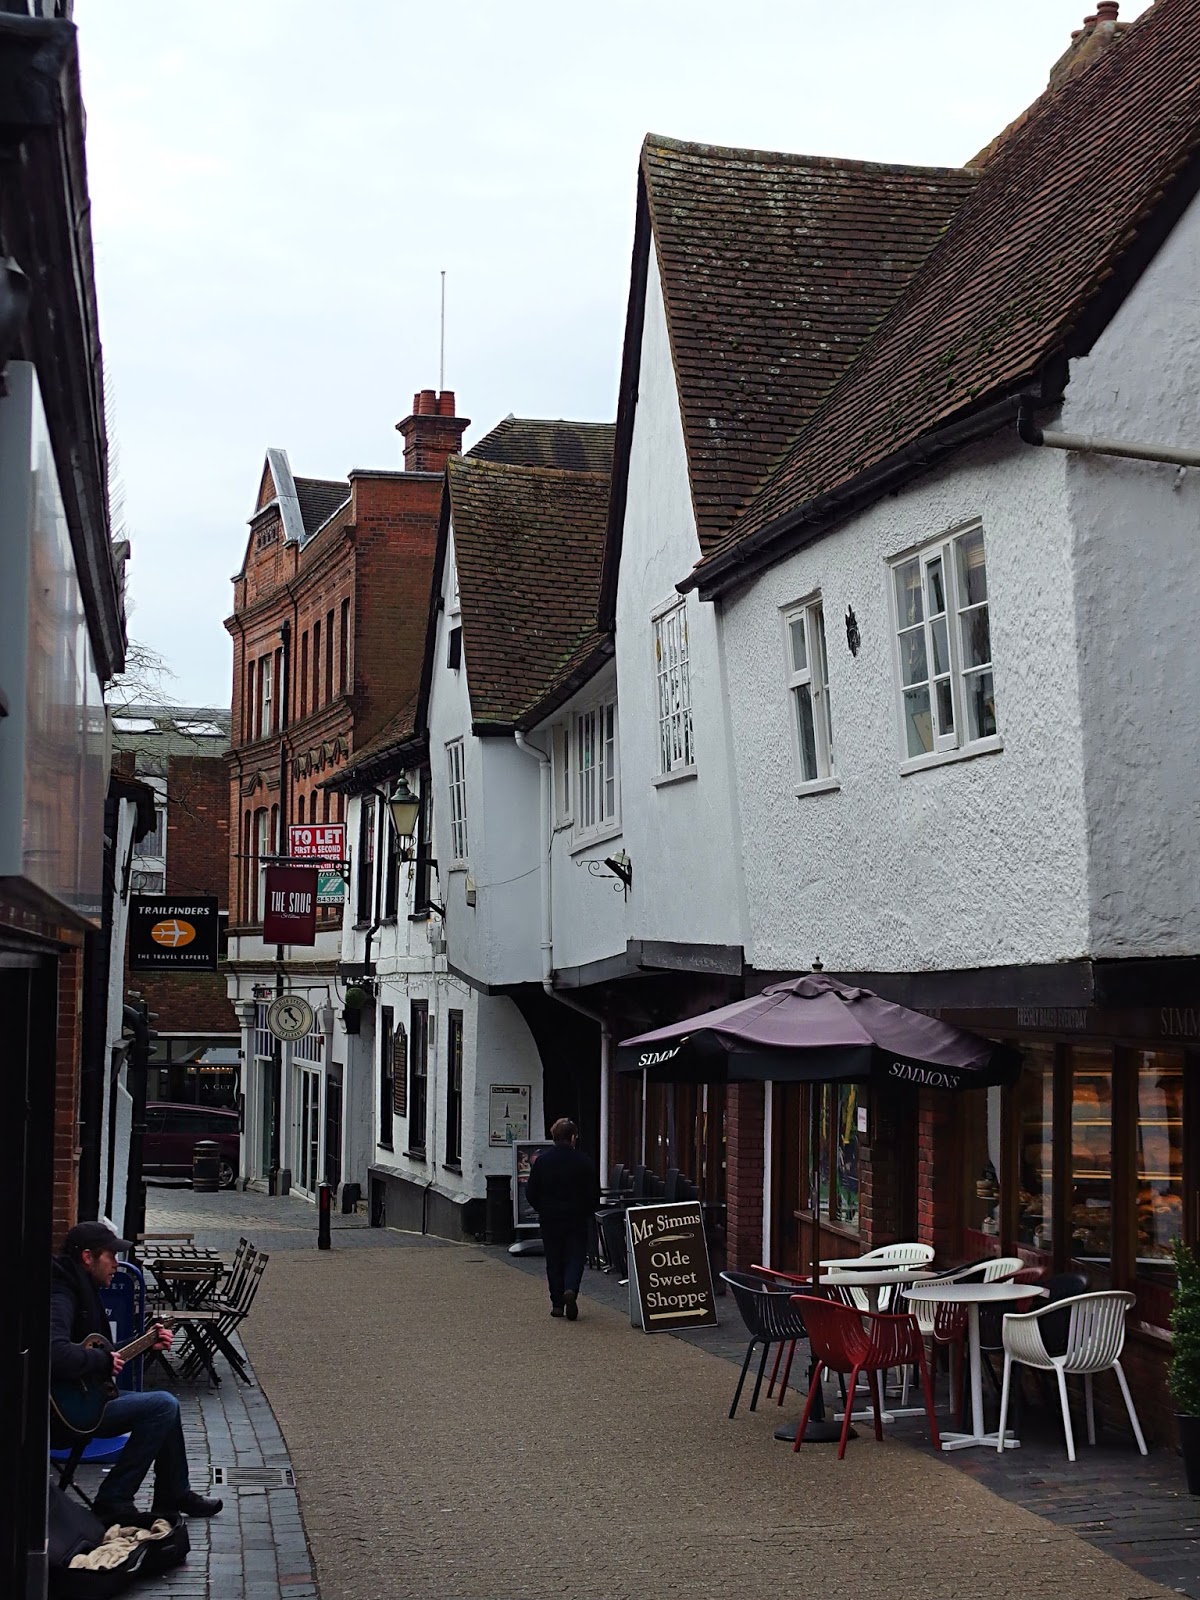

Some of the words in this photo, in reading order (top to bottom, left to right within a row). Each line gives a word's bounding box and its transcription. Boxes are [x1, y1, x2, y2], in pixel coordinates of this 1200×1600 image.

[292, 830, 312, 846] TO
[316, 829, 342, 845] LET
[294, 846, 311, 854] FIRST
[318, 845, 341, 853] SECOND
[138, 906, 211, 916] TRAILFINDERS
[271, 891, 286, 912] THE
[289, 892, 311, 914] SNUG
[138, 953, 151, 961] THE
[888, 1062, 961, 1089] SIMMONS
[632, 1219, 654, 1246] Mr
[657, 1214, 701, 1232] Simms
[651, 1250, 691, 1268] Olde
[649, 1271, 698, 1288] Sweet
[647, 1291, 707, 1308] Shoppe
